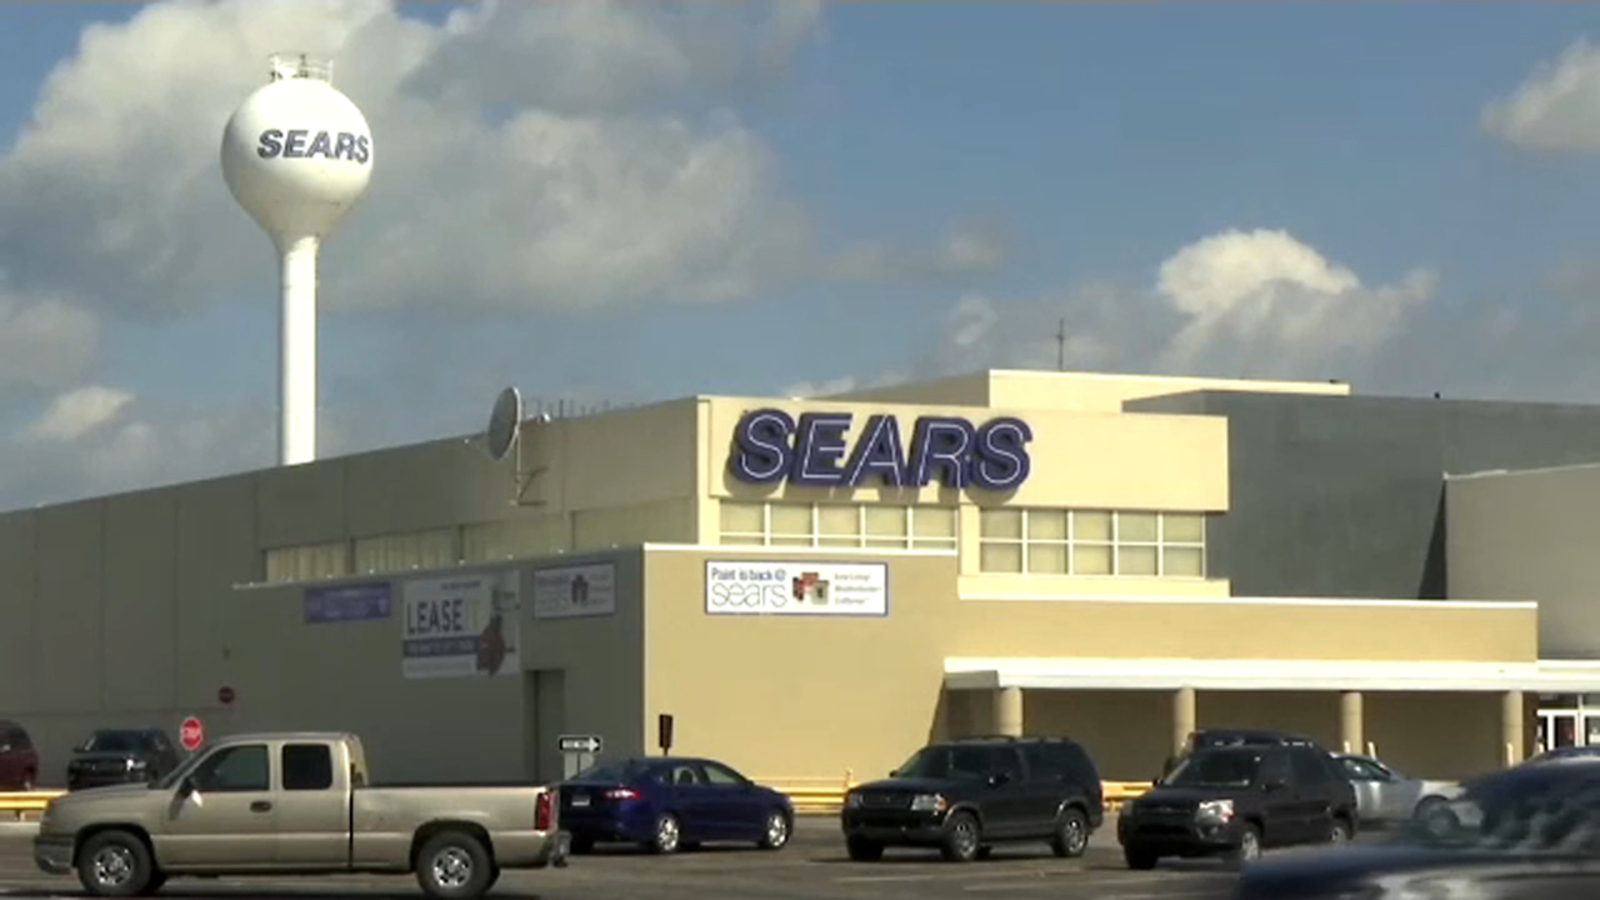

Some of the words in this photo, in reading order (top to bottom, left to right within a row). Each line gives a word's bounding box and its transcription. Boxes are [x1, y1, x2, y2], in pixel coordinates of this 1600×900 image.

[257, 129, 369, 163] SEARS
[731, 408, 1034, 490] SEARS
[711, 567, 735, 580] Paint
[739, 567, 748, 580] is
[750, 567, 772, 580] back
[711, 582, 788, 608] sears
[407, 599, 463, 634] LEASE
